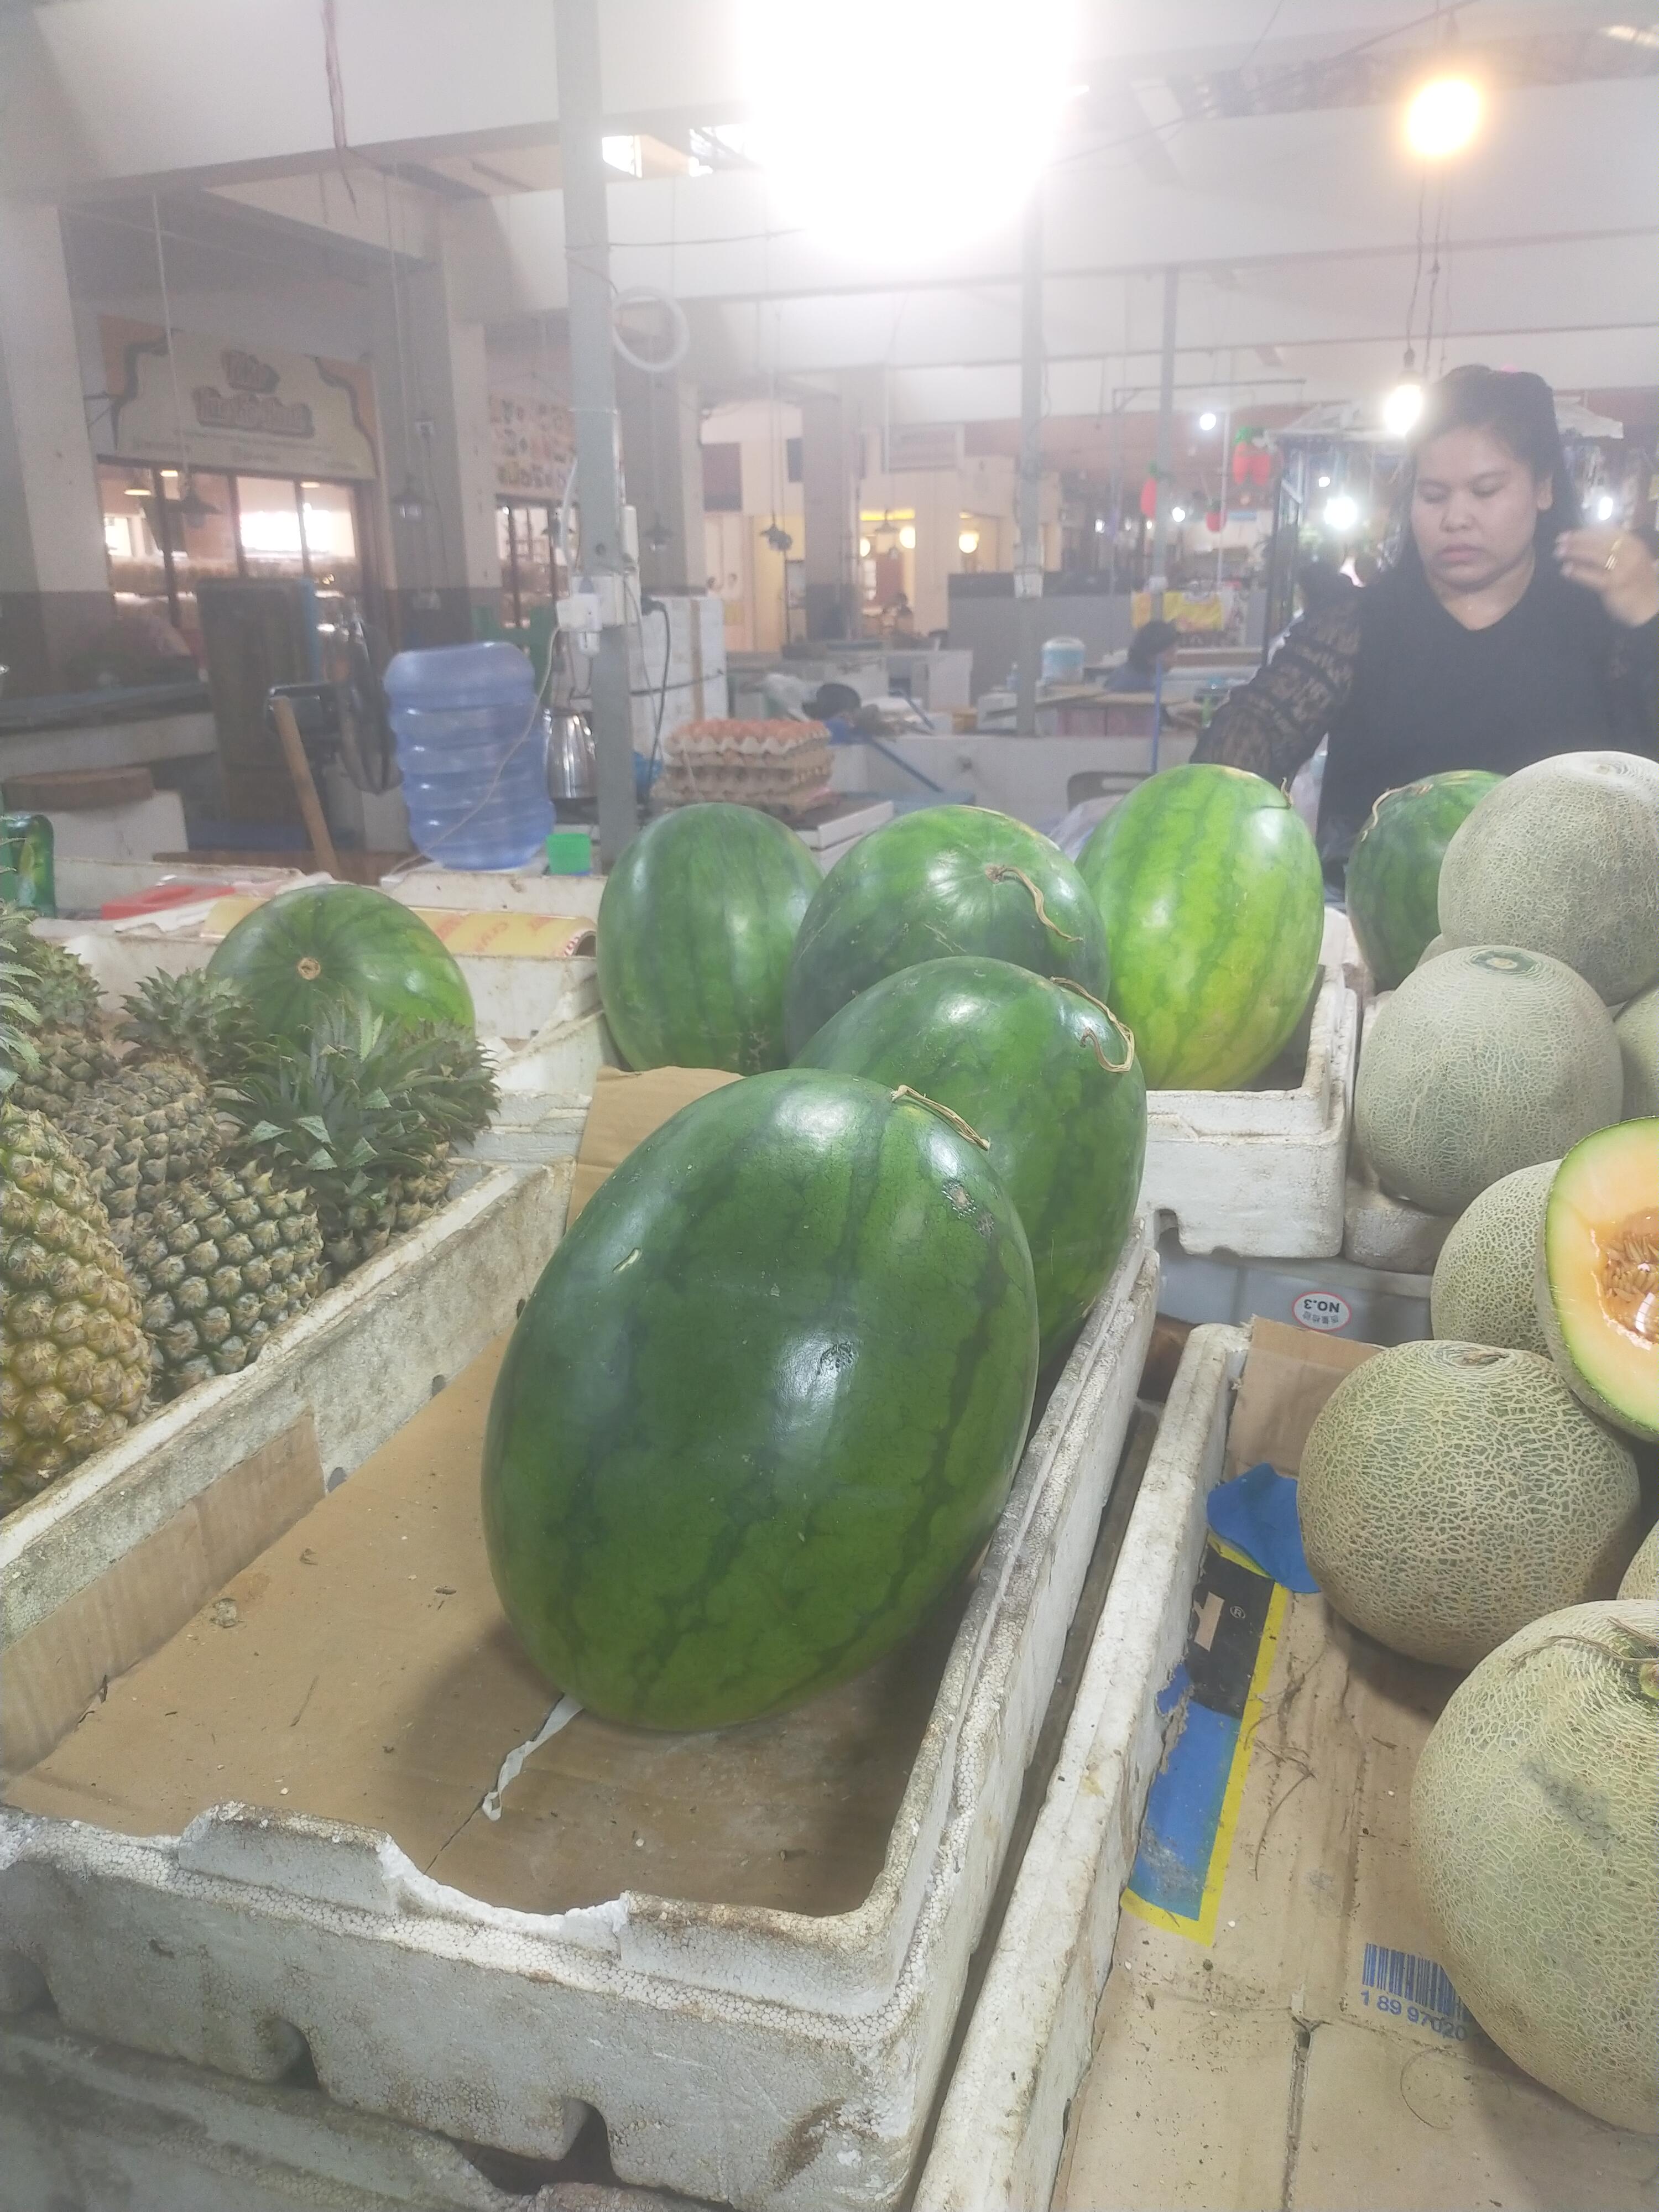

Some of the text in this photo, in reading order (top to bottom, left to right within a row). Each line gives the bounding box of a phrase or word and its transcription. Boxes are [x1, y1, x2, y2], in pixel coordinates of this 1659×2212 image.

[1304, 1299, 1339, 1313] NO.3
[1360, 1990, 1370, 2006] 1
[1376, 1995, 1402, 2015] 89
[1407, 2006, 1467, 2042] 97020
